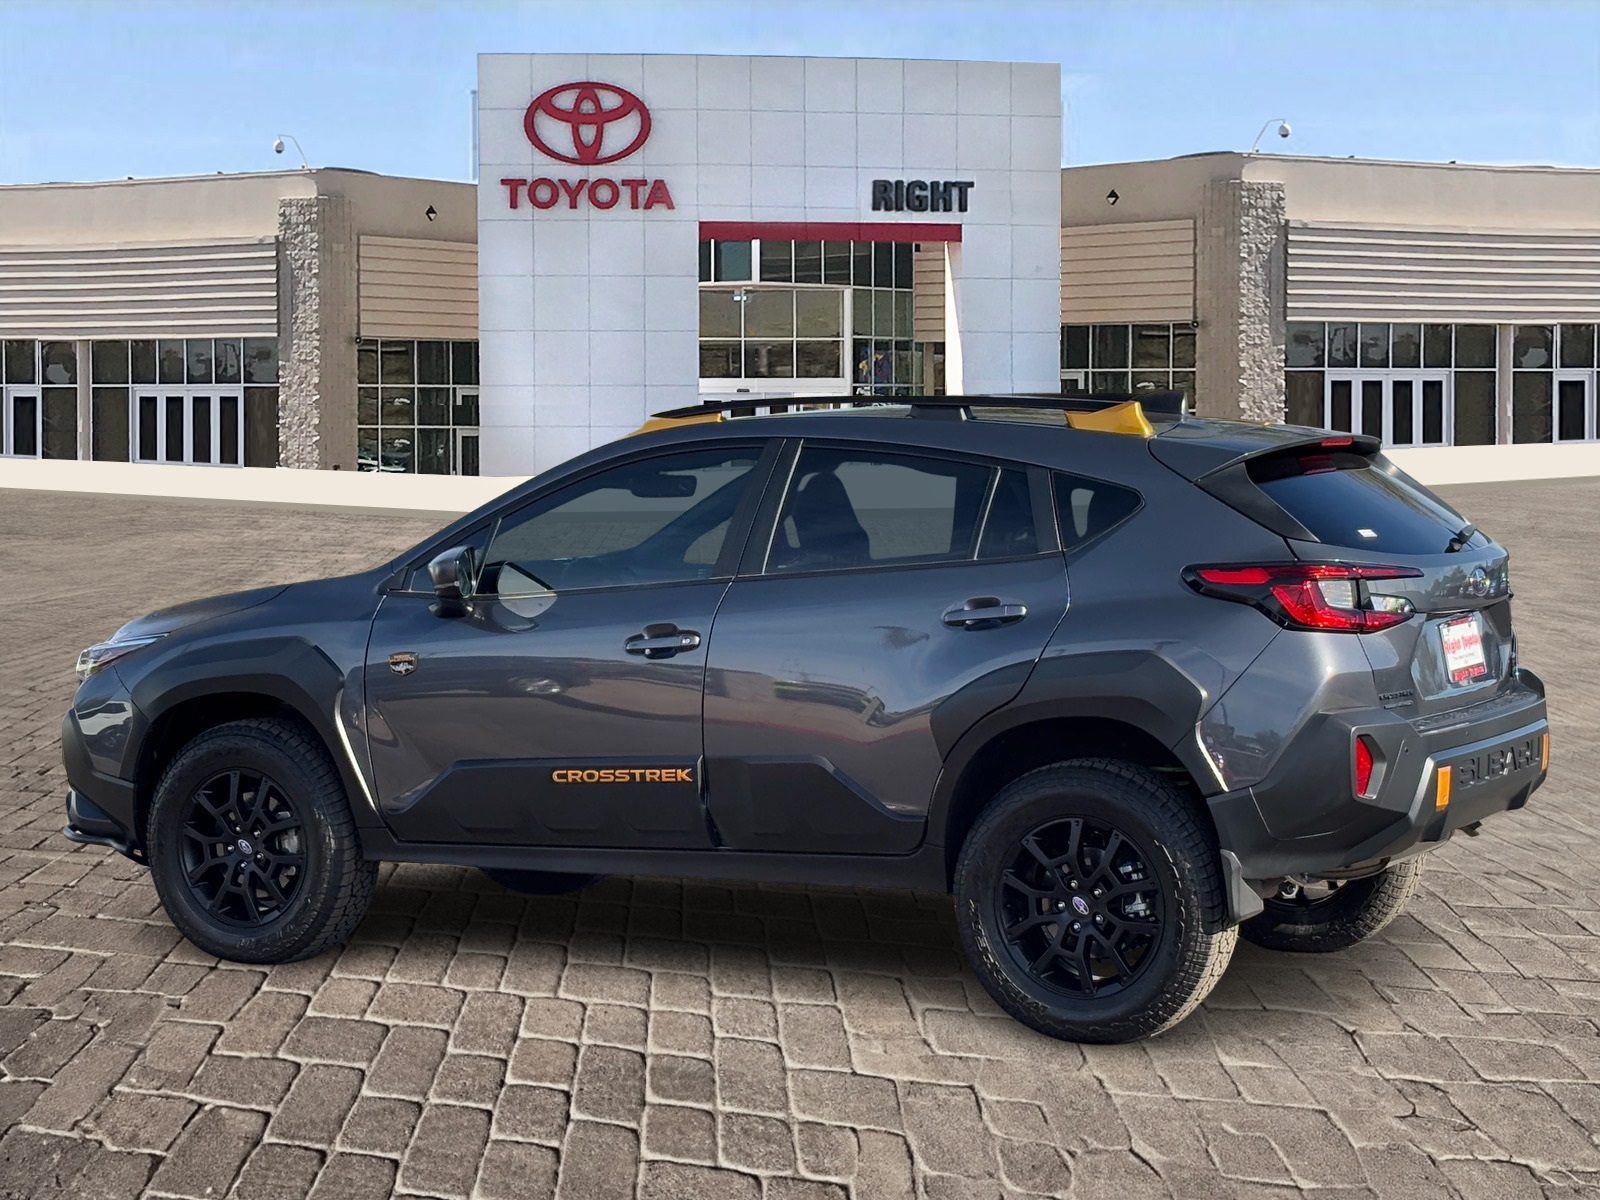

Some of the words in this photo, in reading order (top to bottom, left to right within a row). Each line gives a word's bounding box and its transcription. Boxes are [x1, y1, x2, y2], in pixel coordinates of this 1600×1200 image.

[500, 178, 675, 210] TOYOTA
[872, 180, 974, 212] RIGHT
[551, 768, 693, 783] CROSSTREK
[1459, 736, 1542, 790] SUBARU
